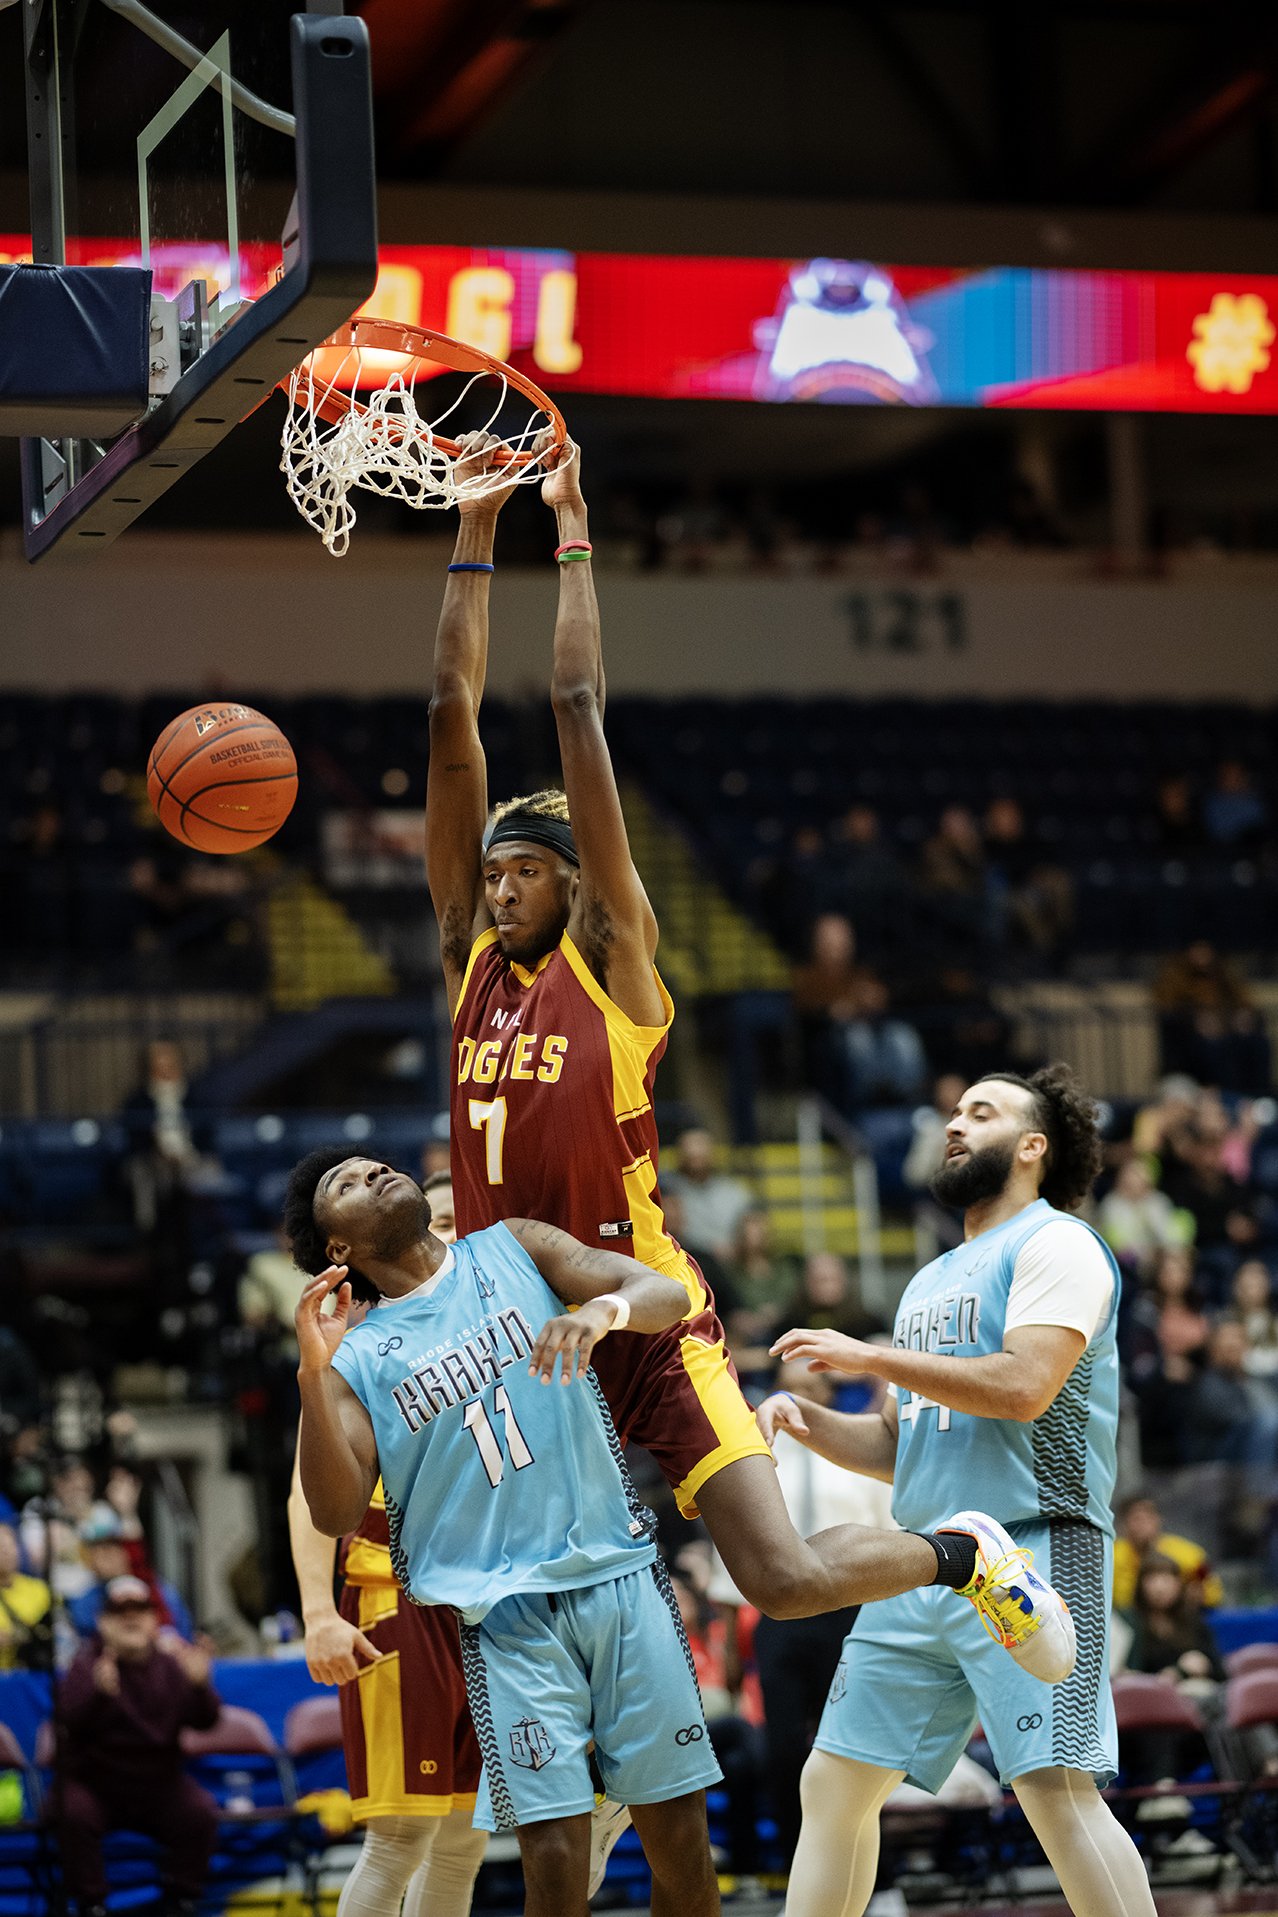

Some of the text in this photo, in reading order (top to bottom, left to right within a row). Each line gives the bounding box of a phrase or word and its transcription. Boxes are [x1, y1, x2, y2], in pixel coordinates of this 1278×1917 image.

[837, 590, 968, 653] 121
[209, 741, 261, 764] BASKETBALL
[228, 753, 262, 768] OFFICIAL
[468, 1096, 508, 1185] 7
[407, 1339, 453, 1370] RHODE
[460, 1384, 536, 1489] 11
